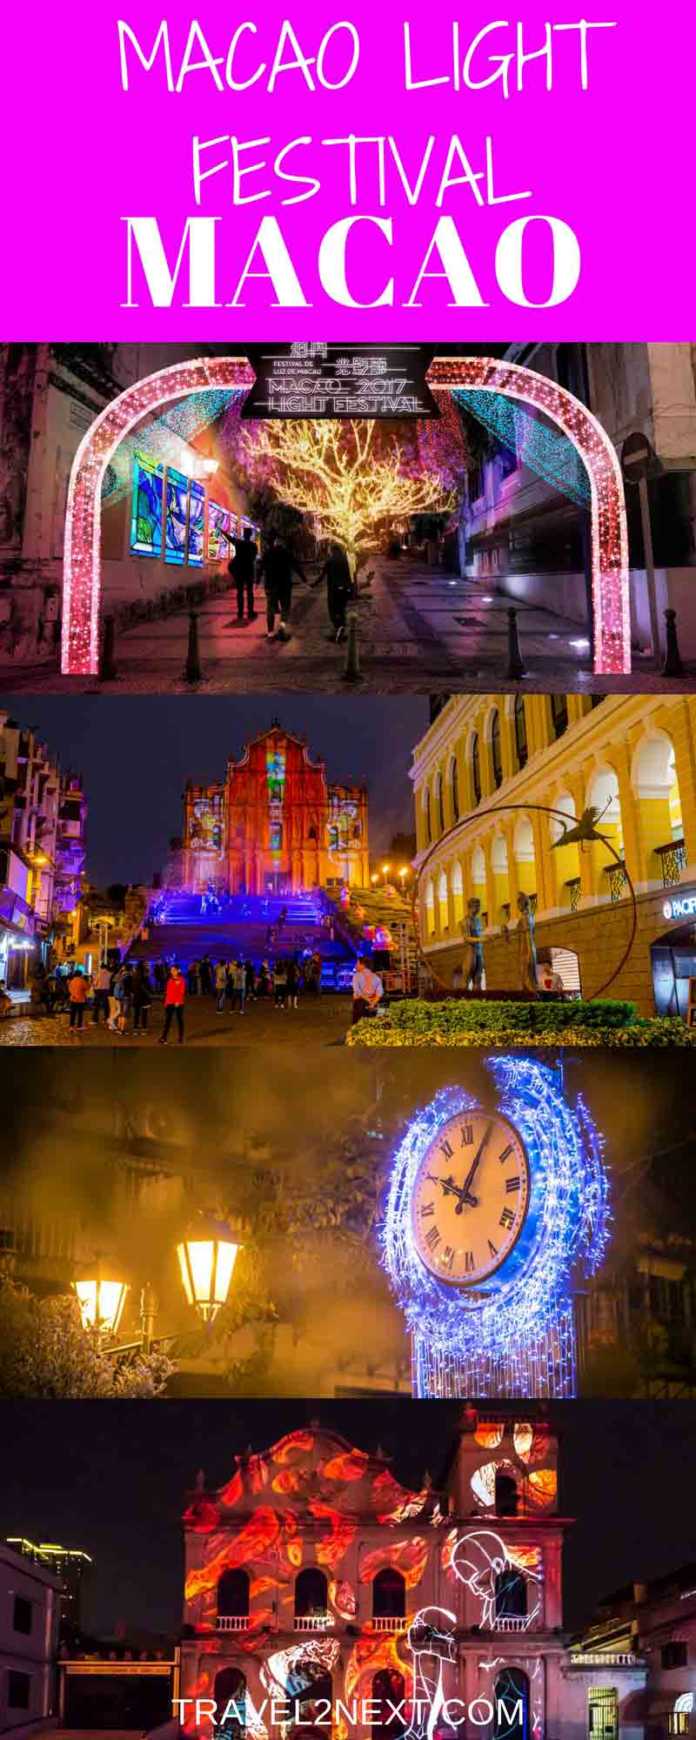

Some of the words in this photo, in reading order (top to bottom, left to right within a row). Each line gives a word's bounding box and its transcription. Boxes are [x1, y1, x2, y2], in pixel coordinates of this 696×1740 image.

[273, 360, 304, 368] FESTIVAL
[304, 360, 314, 368] DE
[273, 368, 286, 376] LUZ
[286, 368, 297, 376] DE
[267, 378, 342, 395] MACAO
[356, 378, 408, 395] 2017
[267, 396, 326, 413] LIGHT
[333, 396, 423, 413] FESTIVAL
[505, 1176, 521, 1193] III
